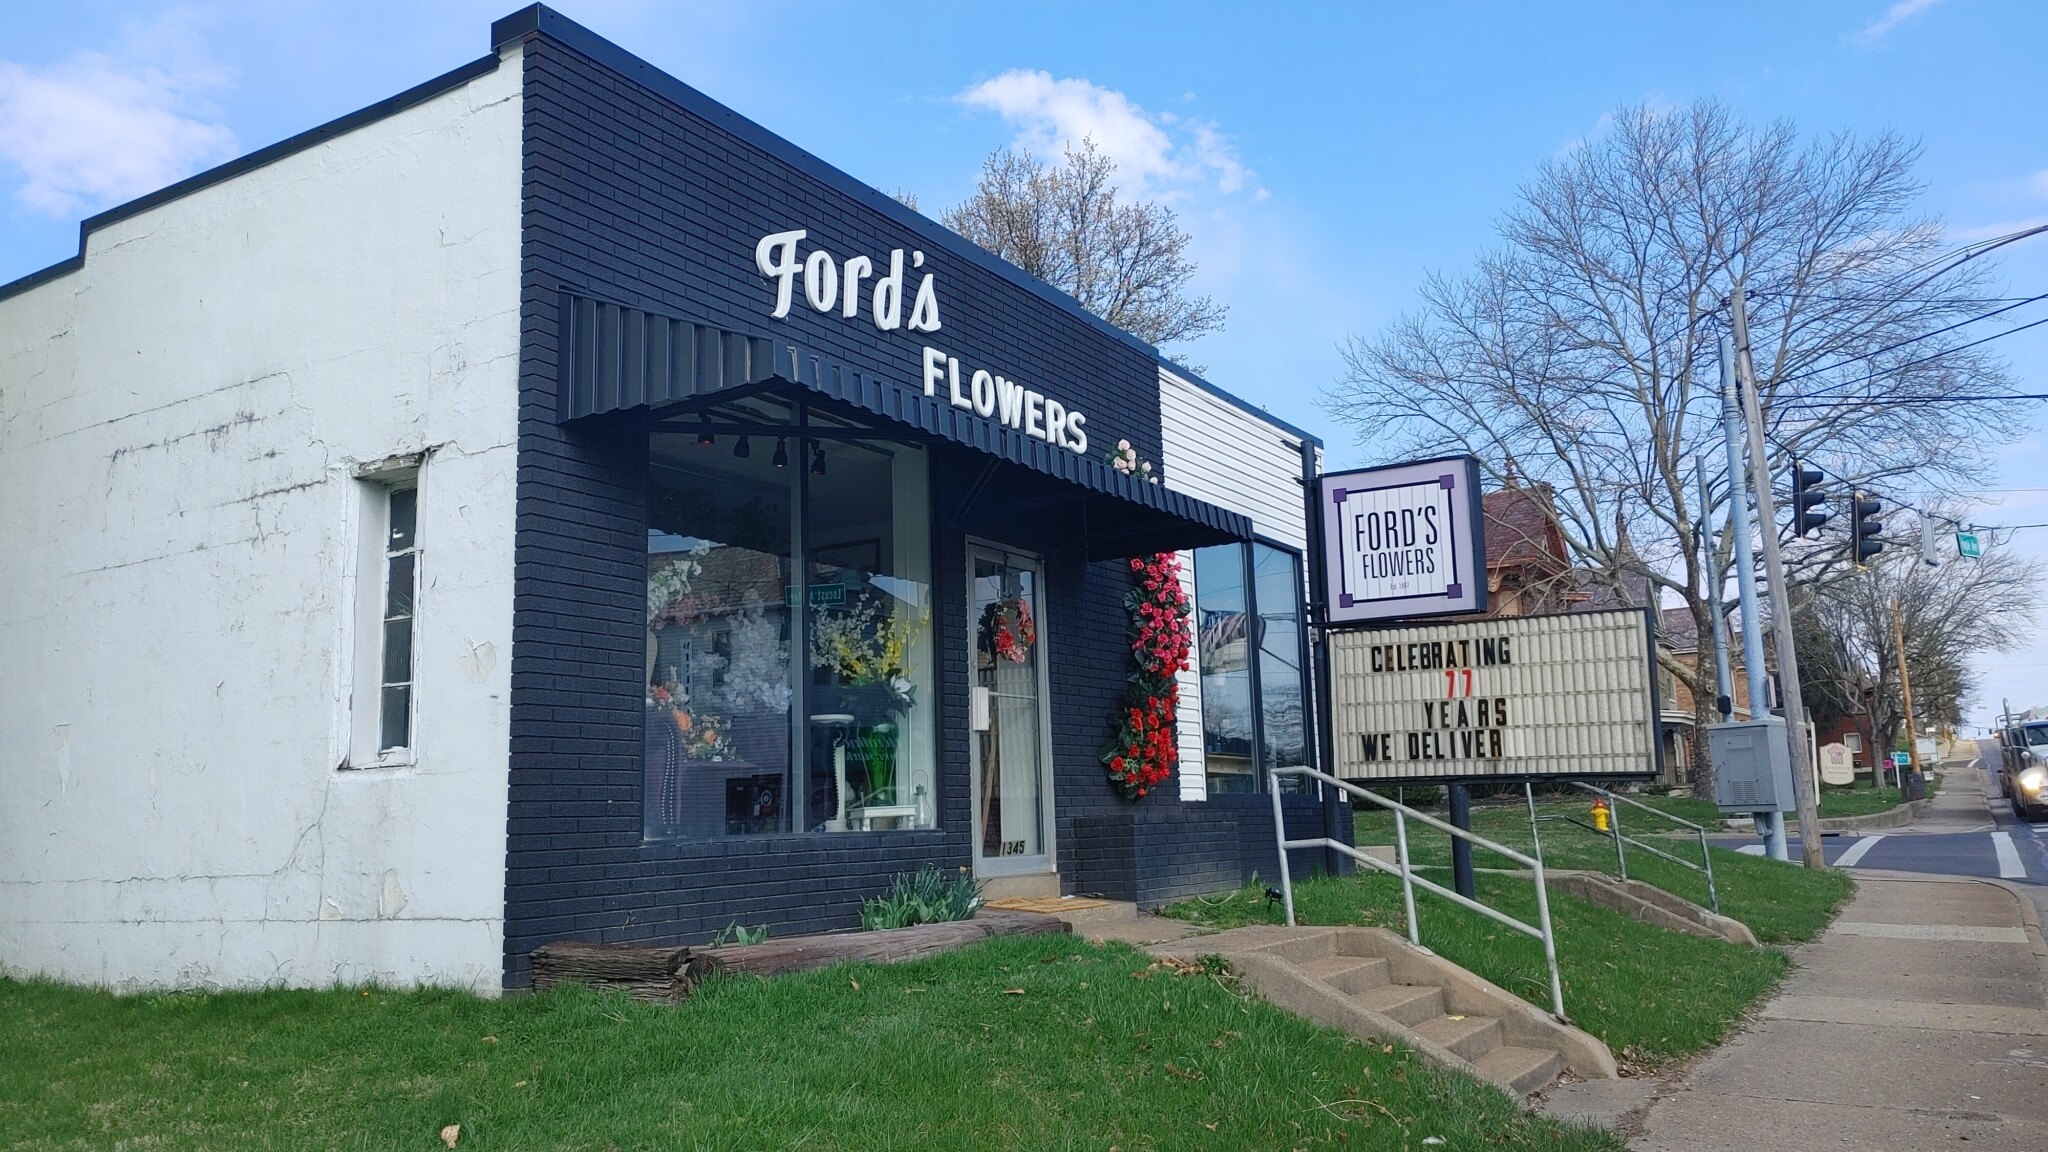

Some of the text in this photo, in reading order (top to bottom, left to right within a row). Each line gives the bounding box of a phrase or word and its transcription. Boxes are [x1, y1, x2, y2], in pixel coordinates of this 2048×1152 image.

[756, 229, 942, 333] Ford's
[923, 346, 1088, 454] FLOWERS
[1355, 505, 1438, 552] FORD'S
[1362, 547, 1435, 579] FLOWERS
[1371, 637, 1511, 672] CELEBRATING
[1445, 669, 1472, 700] 77
[1424, 697, 1507, 729] YEARS
[1361, 728, 1503, 761] WE DELIVER
[1002, 840, 1026, 856] 1345
